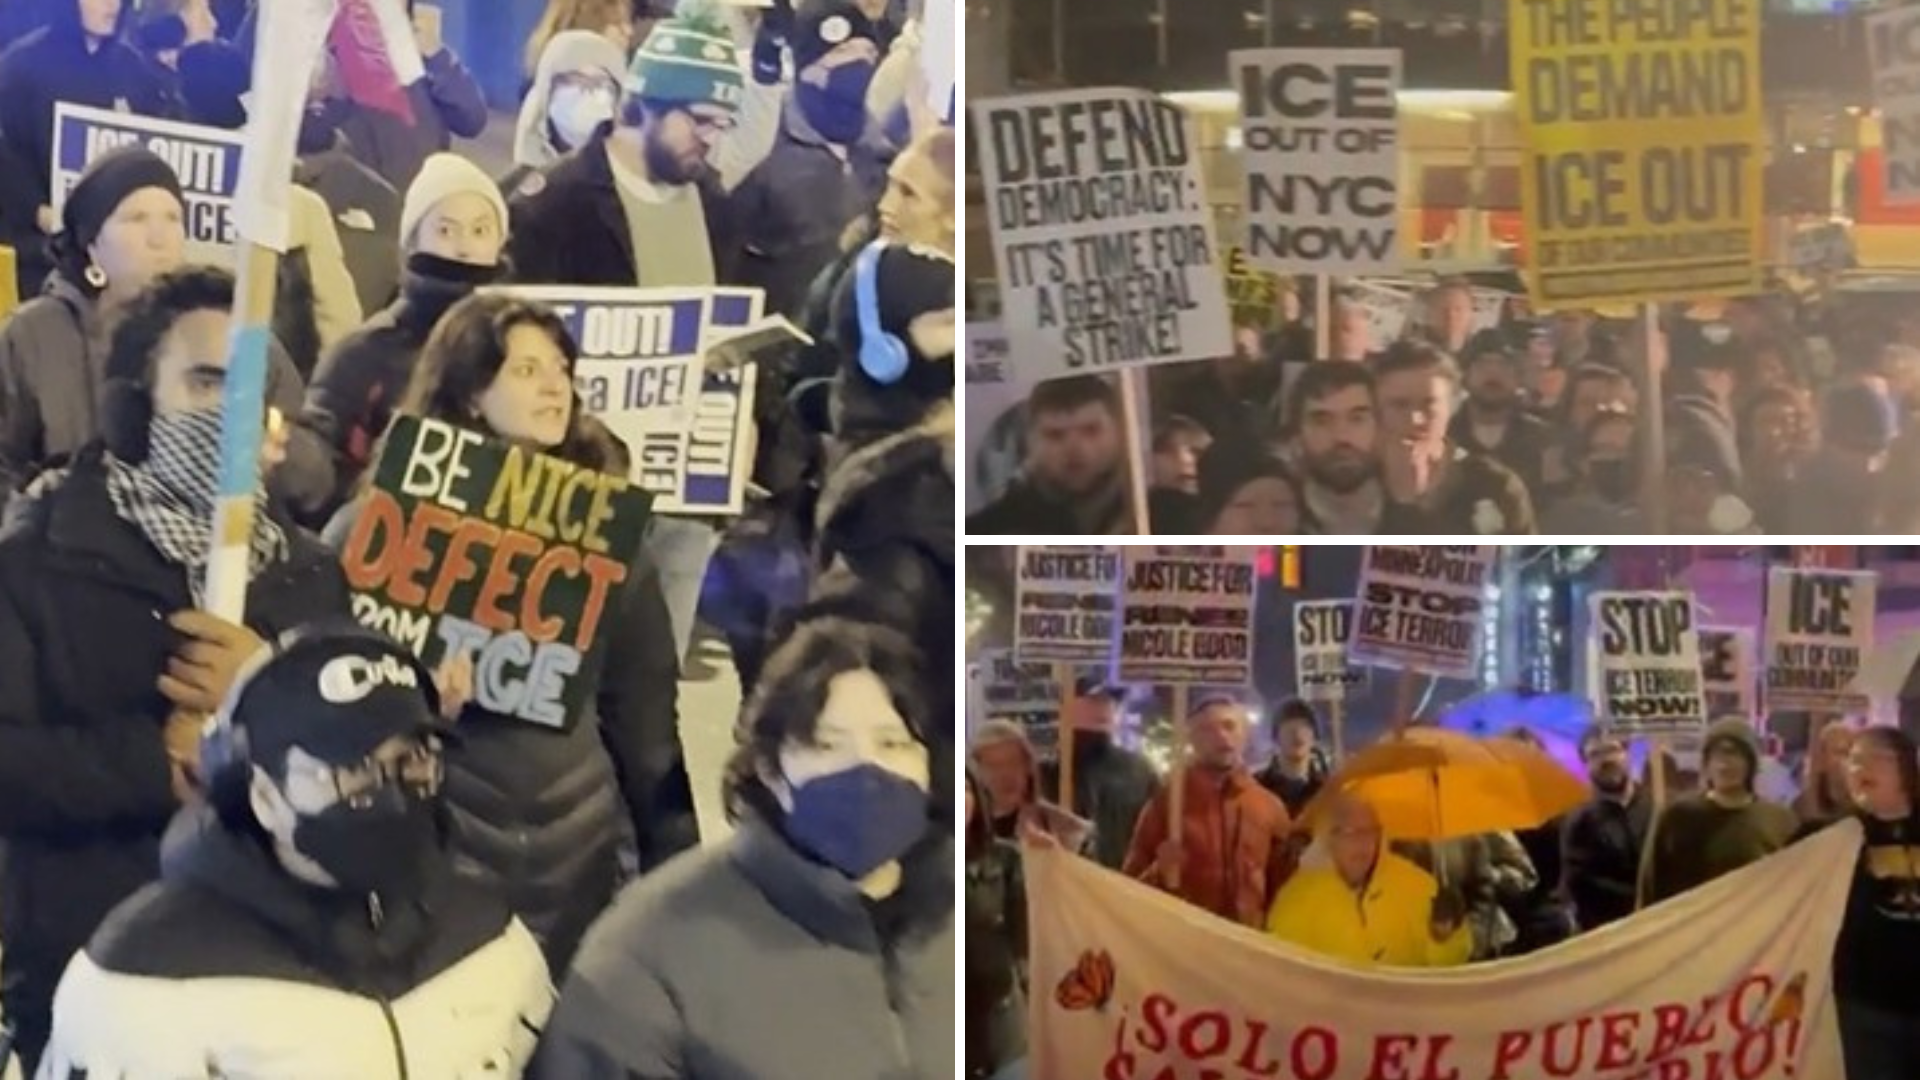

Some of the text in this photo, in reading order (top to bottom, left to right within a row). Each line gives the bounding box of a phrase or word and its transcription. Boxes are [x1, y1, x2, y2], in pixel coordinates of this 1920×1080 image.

[1241, 62, 1397, 119] ICE
[1529, 48, 1748, 124] DEMAND
[990, 98, 1188, 182] DEFEND
[1245, 126, 1396, 154] OUT OF
[997, 170, 1199, 230] DEMOCRACY:
[1248, 172, 1396, 217] NYC
[1535, 143, 1752, 230] ICE OUT
[1071, 230, 1144, 278] TIME
[1152, 224, 1210, 272] FOR
[1249, 224, 1396, 262] NOW
[1036, 285, 1057, 328] A
[1062, 270, 1197, 325] GENERAL
[582, 305, 675, 356] OUT!
[1063, 311, 1182, 368] STRIKE!
[623, 364, 688, 411] ICE!
[401, 417, 628, 552] BE NICE
[340, 487, 627, 651] DEFECT
[1021, 551, 1117, 582] JUSTICE FO
[1127, 559, 1253, 595] JUSTICE FOR
[1299, 604, 1355, 646] STO
[1366, 582, 1481, 616] STOP
[1600, 597, 1691, 656] STOP
[1789, 572, 1853, 637] ICE
[351, 592, 582, 728] ROM ICE
[1608, 696, 1699, 717] NOW!
[1364, 1033, 1460, 1080] EL
